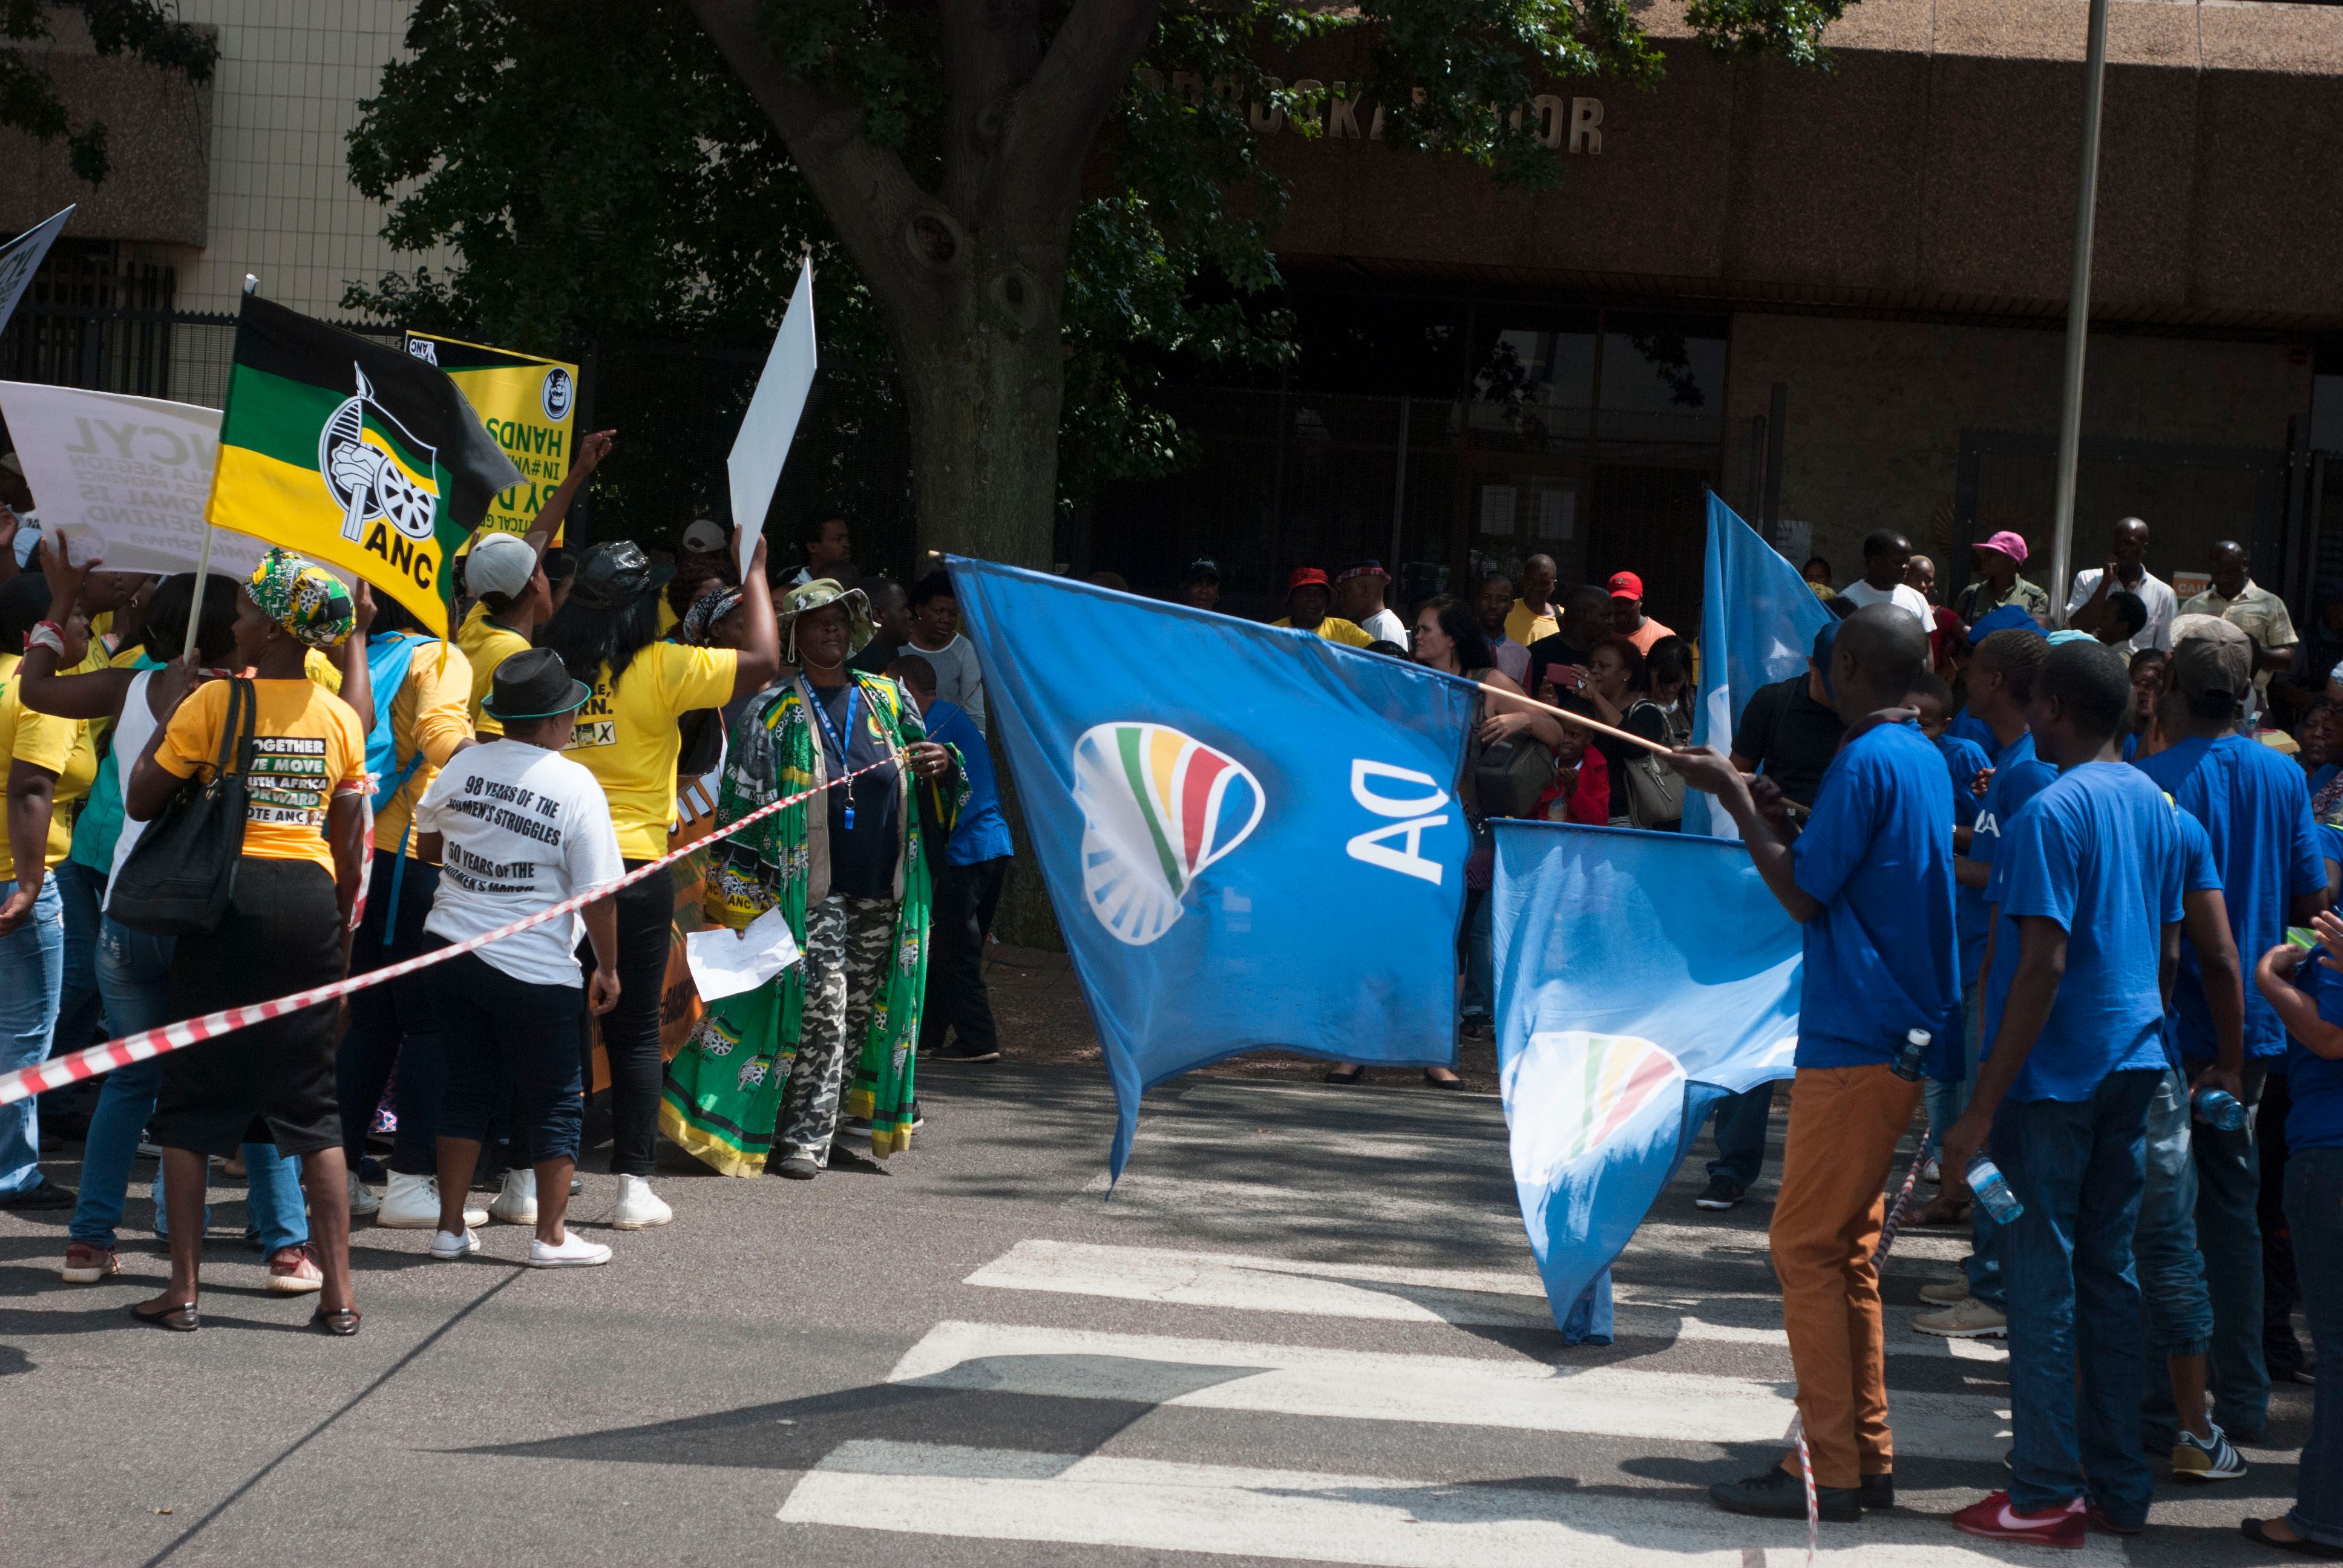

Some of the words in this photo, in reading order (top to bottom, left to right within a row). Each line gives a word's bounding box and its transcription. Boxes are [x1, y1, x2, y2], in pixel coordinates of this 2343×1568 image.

[411, 341, 428, 355] ANC
[486, 417, 563, 457] HANDS
[507, 454, 541, 476] #VM
[543, 461, 560, 480] IN
[364, 522, 433, 589] ANC
[578, 699, 614, 716] RN.
[252, 739, 324, 754] OGETHER
[274, 759, 322, 773] MOVE
[247, 776, 276, 787] UTH
[280, 777, 327, 789] AFRICA
[246, 787, 318, 806] ORWARD
[464, 776, 484, 795] 98
[484, 781, 518, 803] YEARS
[516, 789, 535, 808] OF
[535, 795, 561, 818] THE
[246, 808, 270, 820] OTE
[275, 810, 304, 822] ANC
[445, 798, 496, 822] WOMEN'S
[494, 808, 561, 846] STRUGGLES
[448, 841, 461, 863] 60
[463, 850, 493, 877] YEARS
[495, 864, 509, 878] OF
[511, 862, 535, 878] THE
[444, 863, 487, 892] WOMEN'S
[727, 895, 752, 909] ANC
[700, 1054, 714, 1065] ANC
[742, 1087, 756, 1097] ANC
